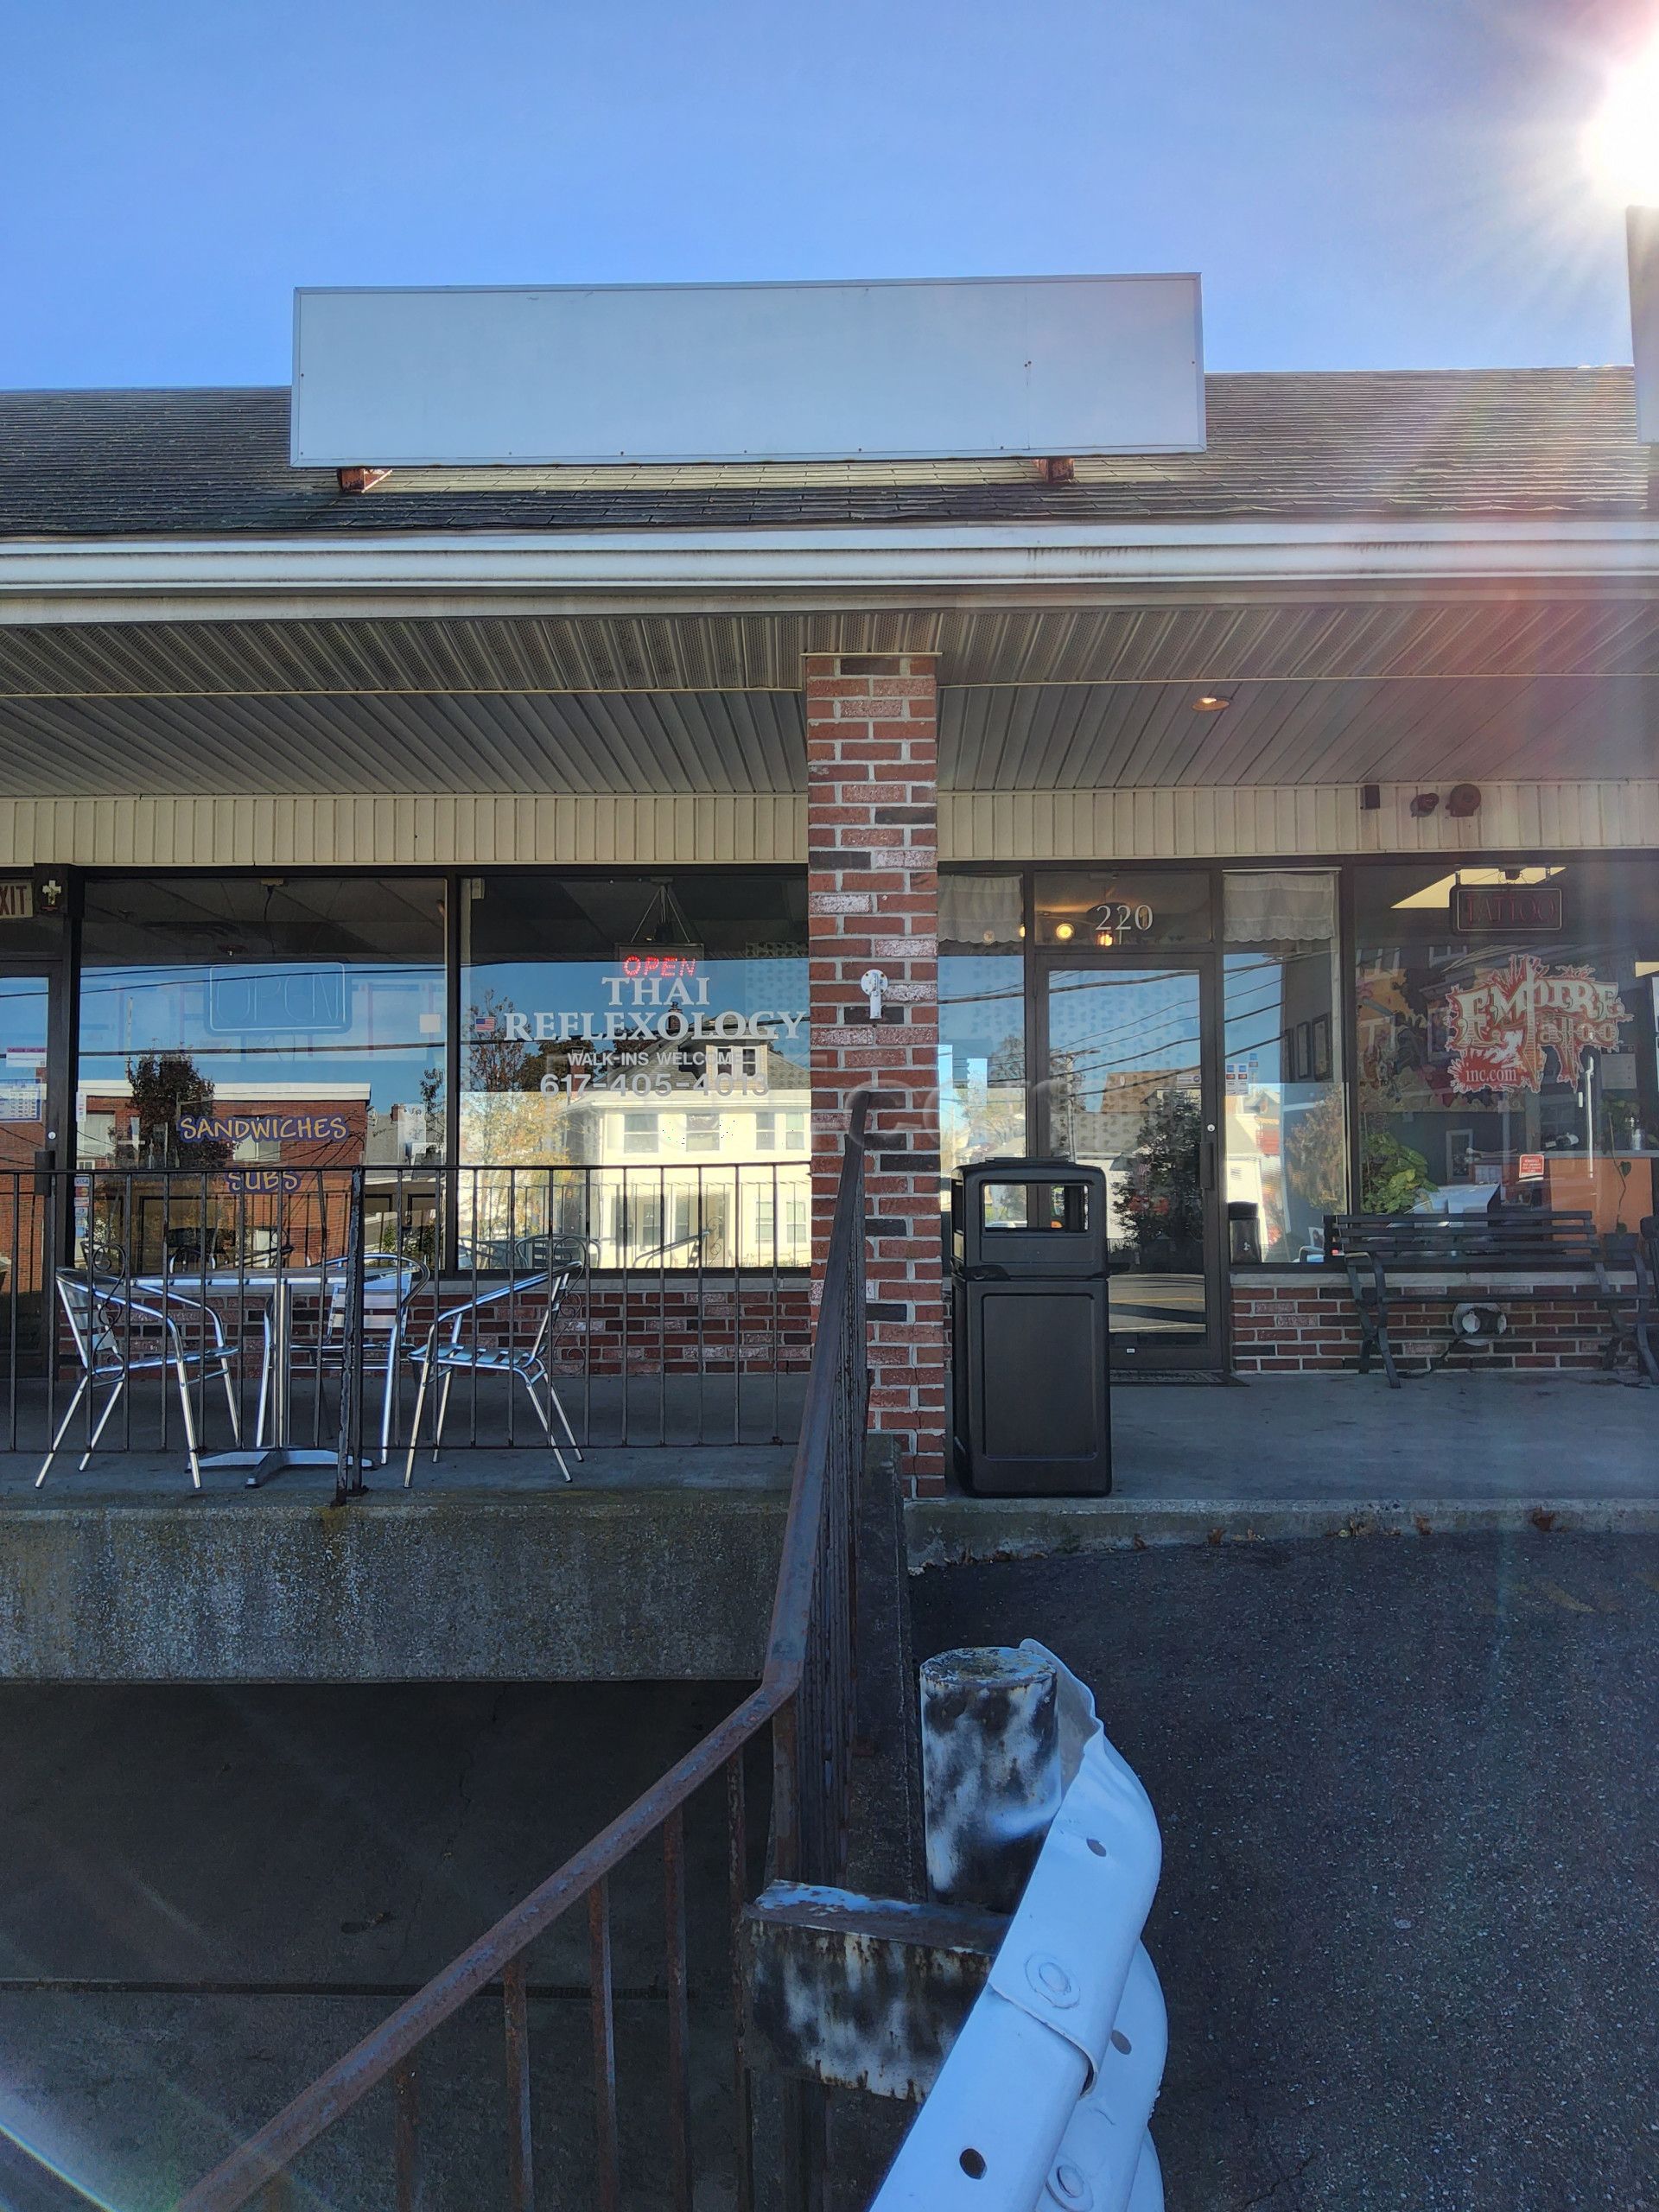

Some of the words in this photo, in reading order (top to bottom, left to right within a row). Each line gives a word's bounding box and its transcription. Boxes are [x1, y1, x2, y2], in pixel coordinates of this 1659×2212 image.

[1095, 905, 1154, 931] 220
[1465, 894, 1557, 925] TATTOO
[622, 954, 696, 976] OPEN
[216, 971, 340, 1023] OPEN
[601, 977, 710, 1006] THAI
[504, 1010, 807, 1041] REFLEXOLOGY
[568, 1052, 650, 1066] WALK-INS
[657, 1051, 744, 1065] WELCOME
[540, 1072, 770, 1097] 617-405-4013
[1465, 1067, 1517, 1083] inc.com
[180, 1116, 347, 1140] SANDWICHES
[228, 1169, 299, 1192] SUBS
